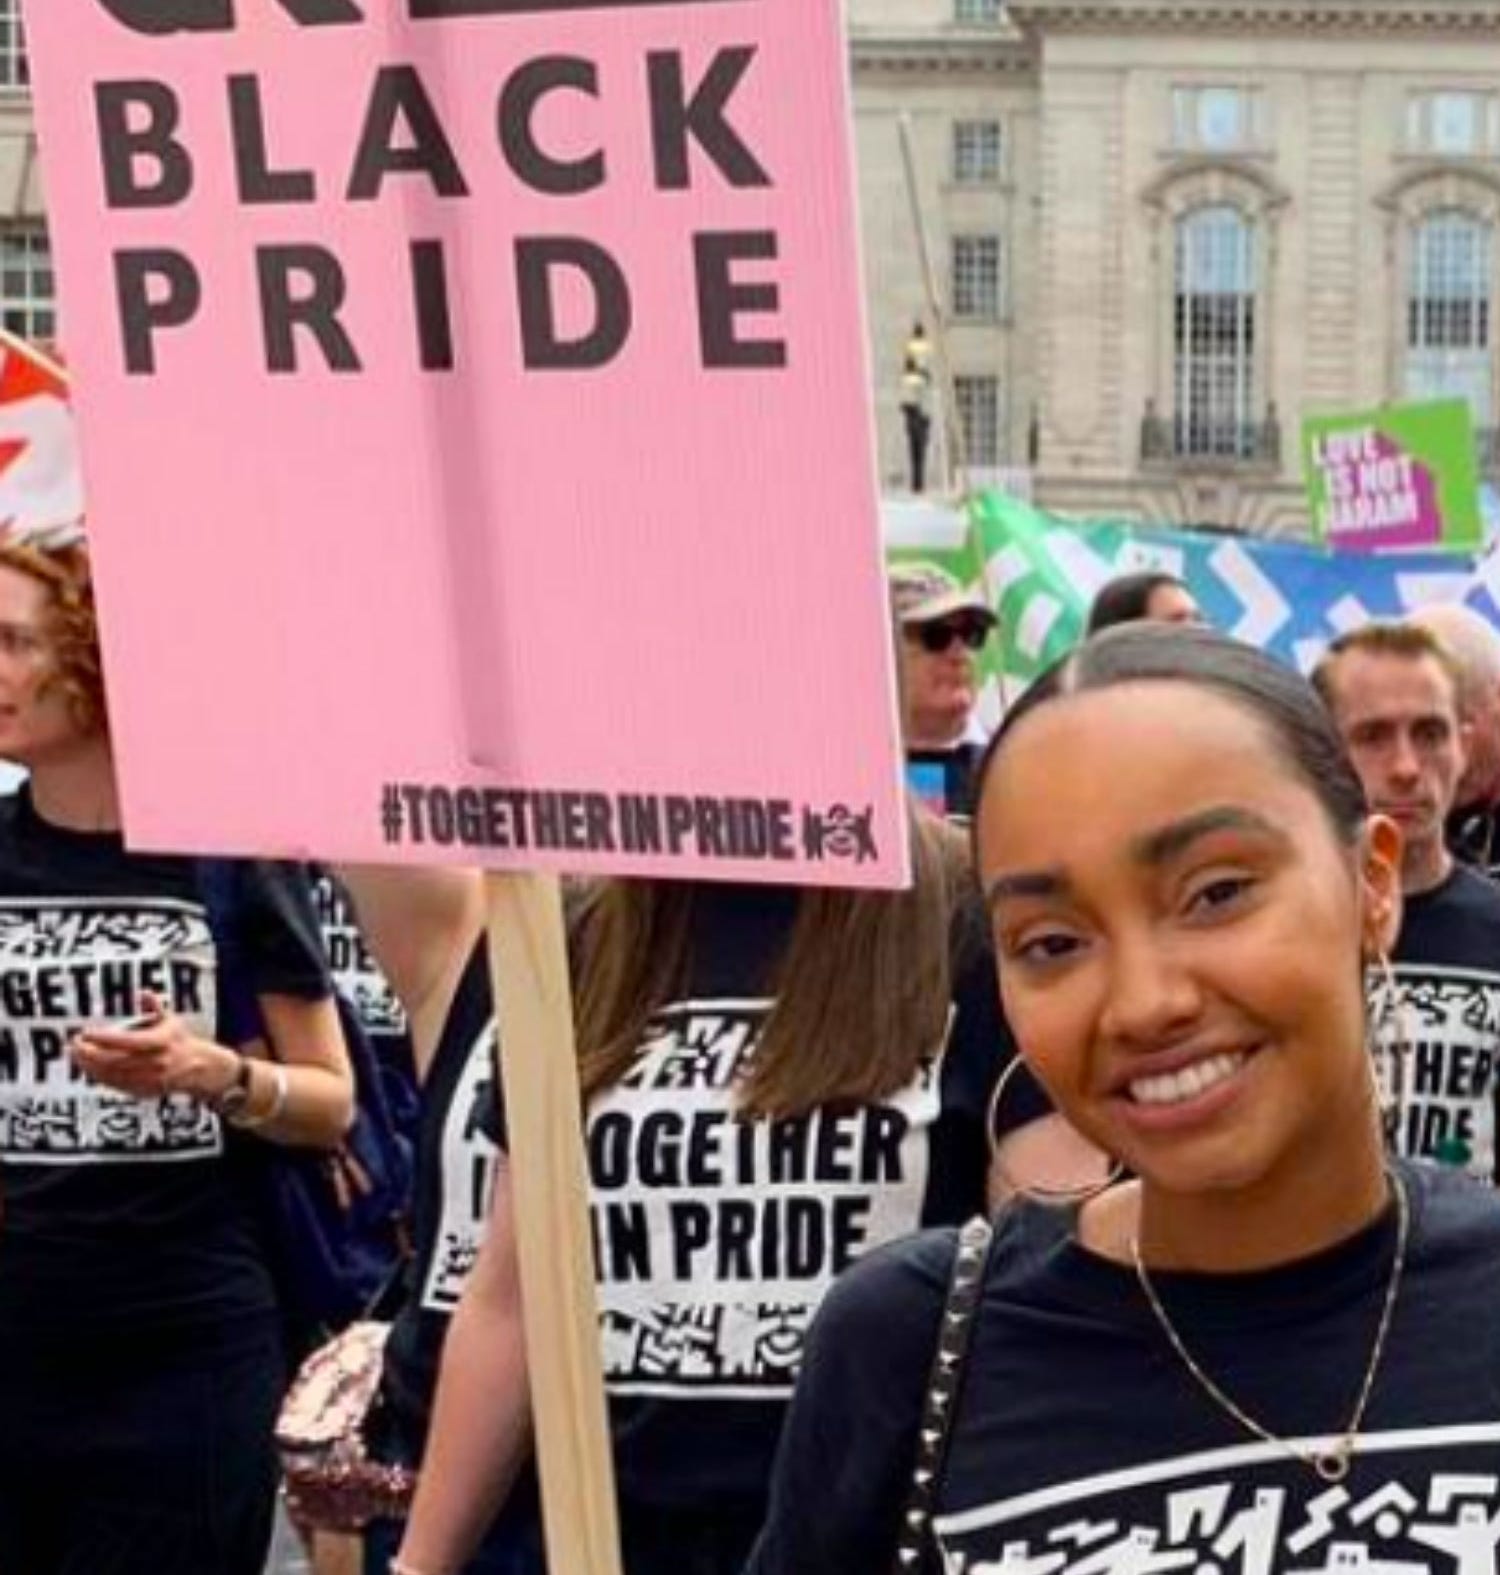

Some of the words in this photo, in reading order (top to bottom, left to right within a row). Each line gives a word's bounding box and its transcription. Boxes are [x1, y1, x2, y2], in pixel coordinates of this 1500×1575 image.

[93, 44, 774, 209] BLACK
[112, 230, 788, 375] PRIDE
[1311, 428, 1379, 467] LOVE
[1358, 454, 1415, 498] NOT
[671, 1195, 871, 1281] PRIDE
